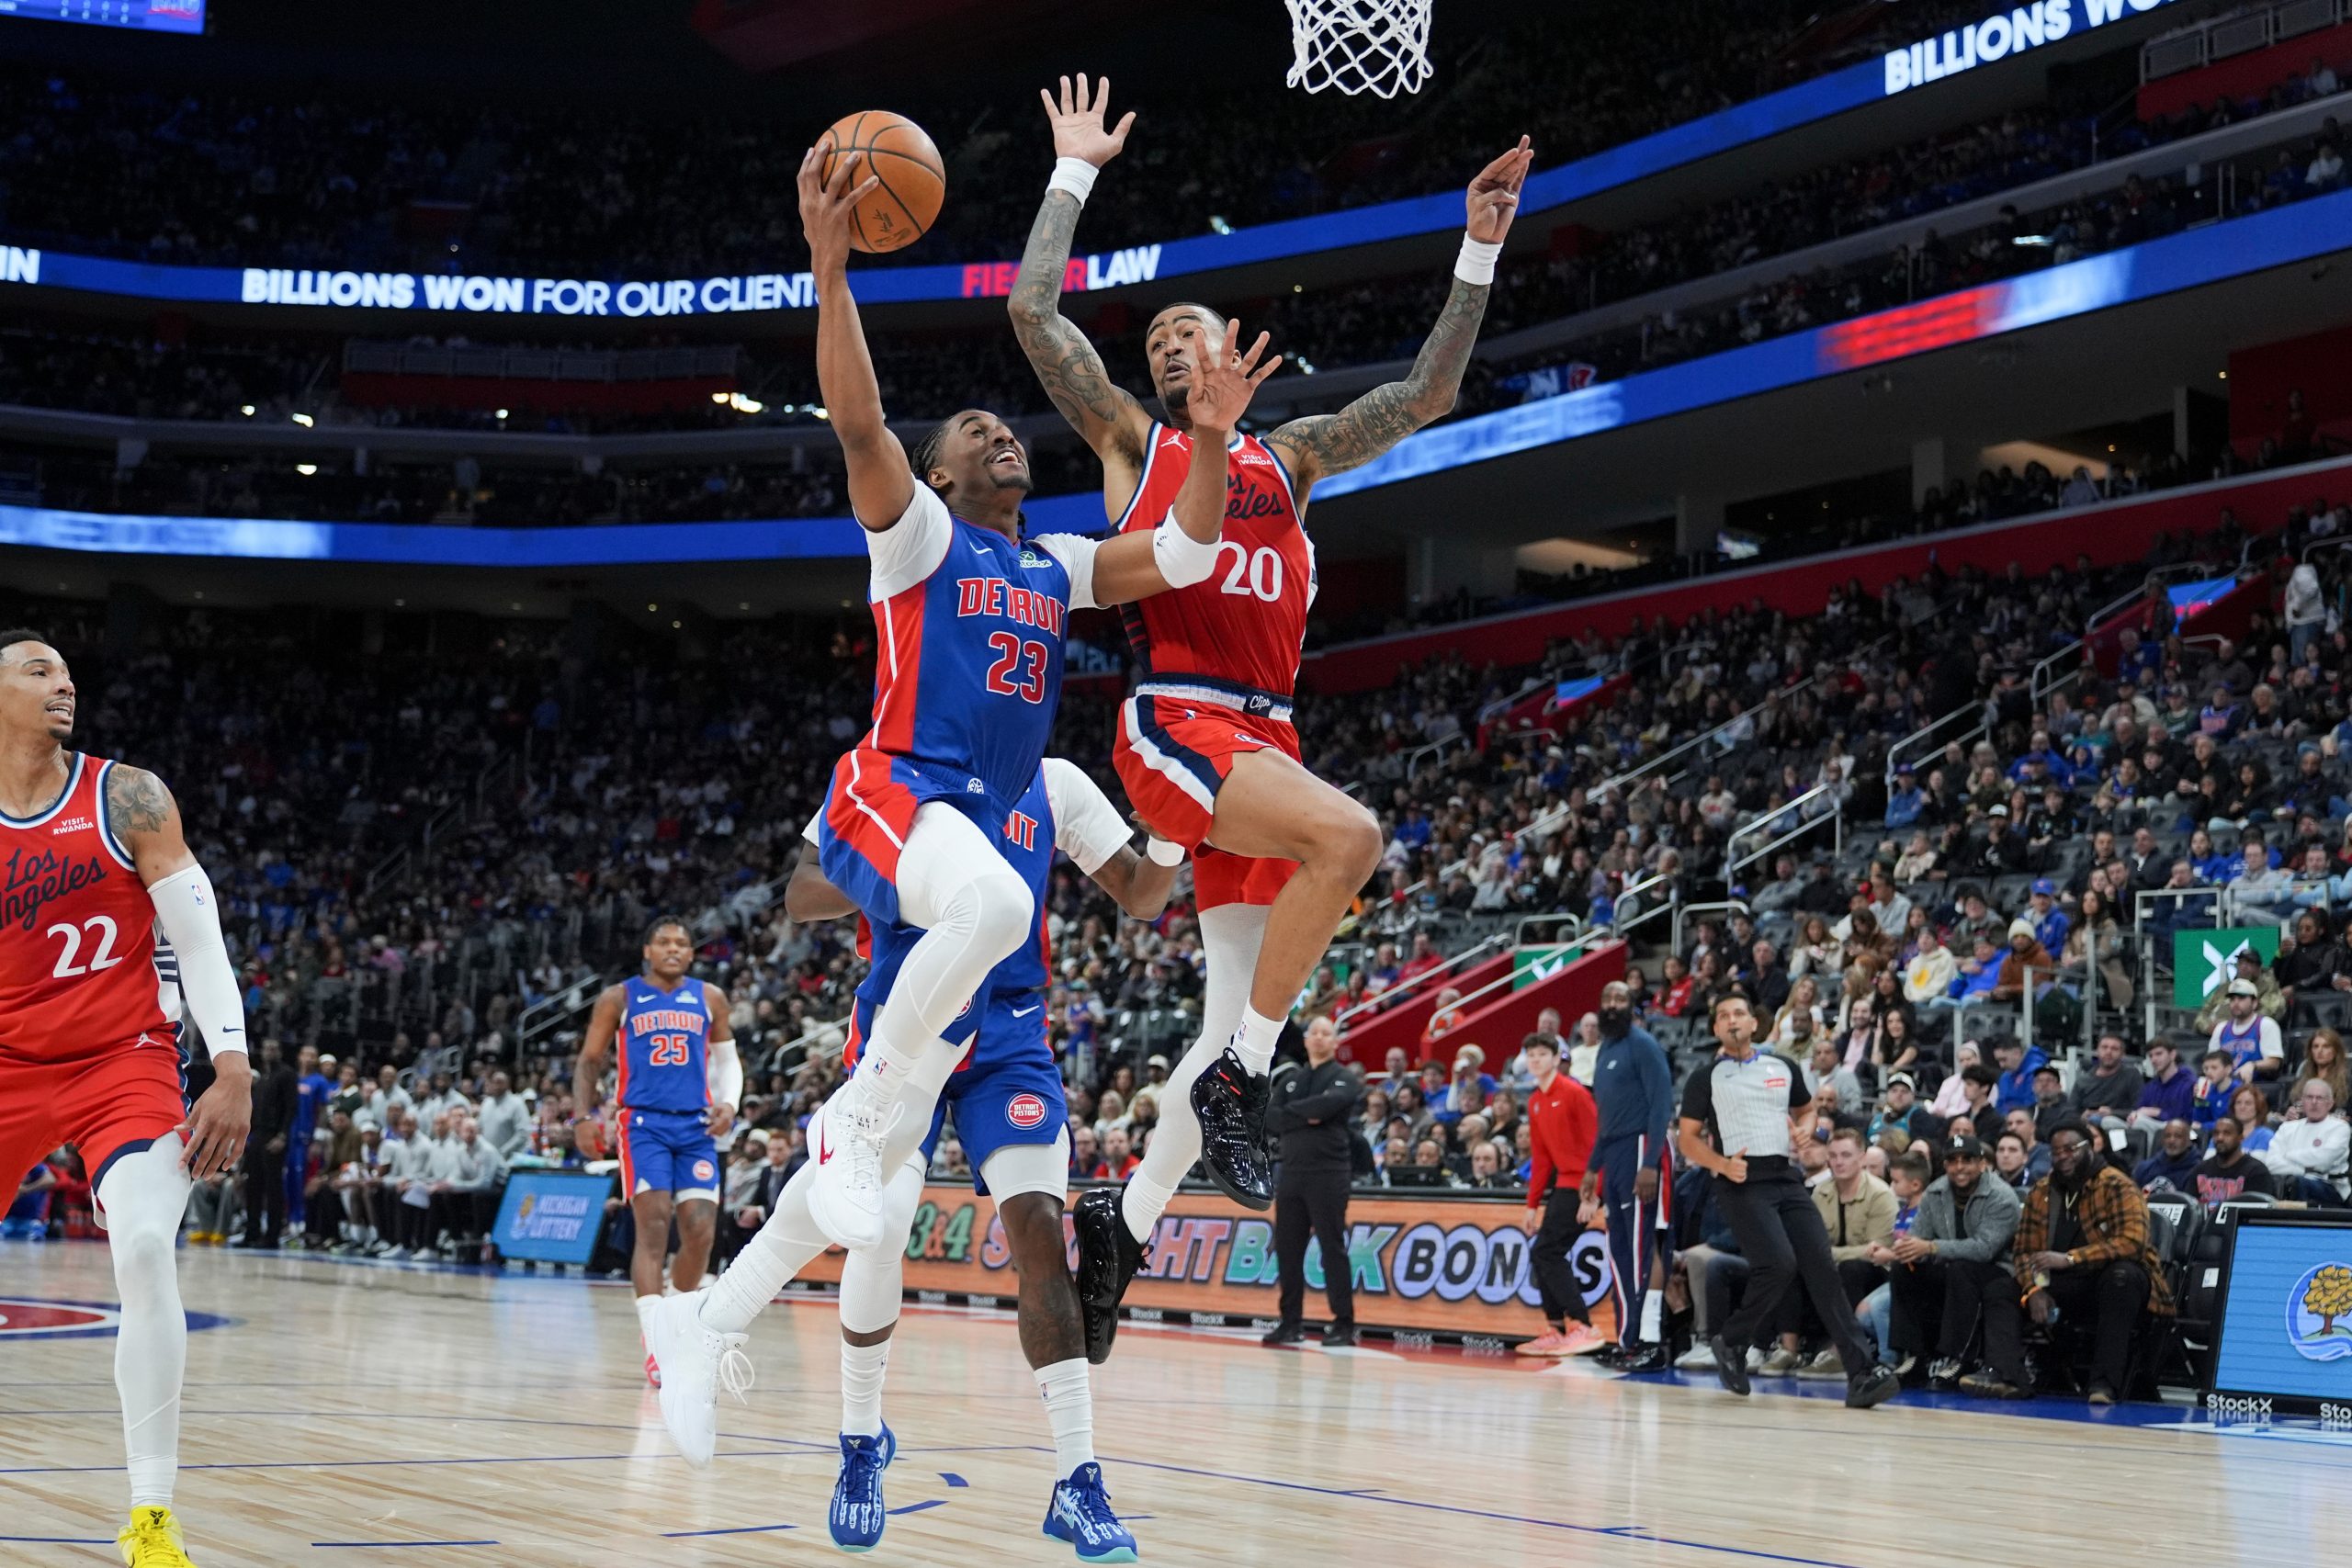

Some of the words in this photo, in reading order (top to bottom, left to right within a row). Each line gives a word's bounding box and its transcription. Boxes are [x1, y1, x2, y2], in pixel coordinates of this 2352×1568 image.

[1884, 0, 2072, 96] BILLIONS
[241, 268, 415, 309] BILLIONS
[423, 275, 525, 312] WON
[533, 278, 610, 316] FOR
[616, 281, 695, 317] OUR
[1225, 484, 1284, 520] eles
[1219, 540, 1283, 602] 20
[956, 577, 1065, 642] DETROIT
[987, 630, 1048, 705] 23
[53, 822, 95, 836] RWANDA
[62, 817, 85, 826] VISIT
[0, 855, 108, 931] ngeles
[6, 847, 60, 892] Los
[47, 915, 123, 978] 22
[630, 1010, 705, 1037] DETROIT
[650, 1033, 690, 1066] 25
[1403, 1236, 1606, 1294] BONS
[2206, 1393, 2273, 1414] StockX
